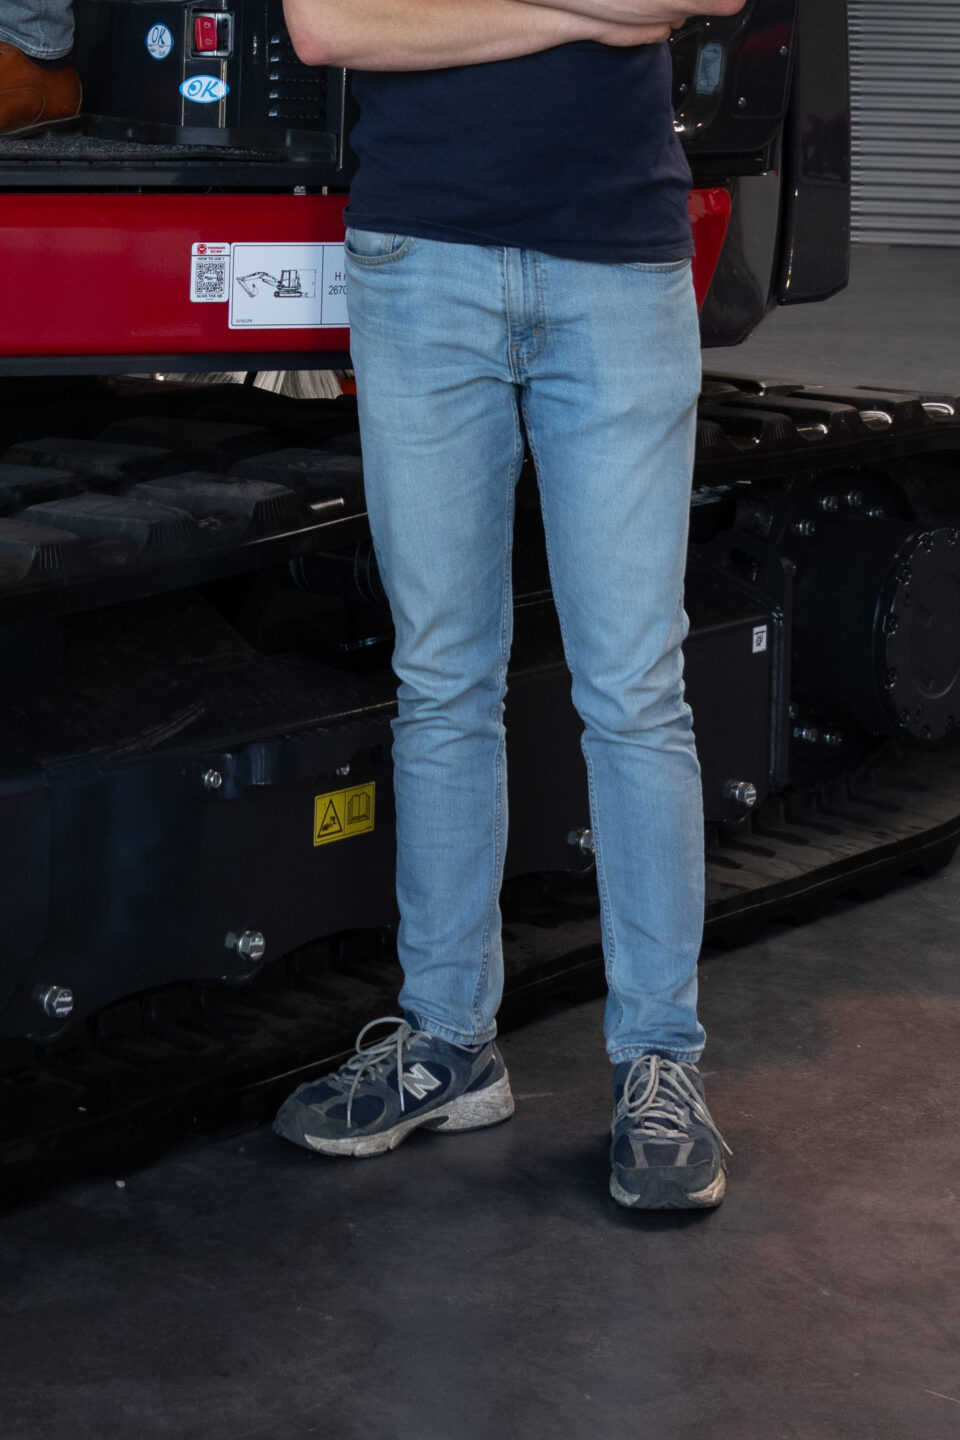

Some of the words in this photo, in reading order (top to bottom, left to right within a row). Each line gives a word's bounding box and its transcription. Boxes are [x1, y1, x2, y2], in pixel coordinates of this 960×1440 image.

[151, 26, 166, 45] OK
[187, 79, 219, 98] OK
[402, 1062, 442, 1100] N
